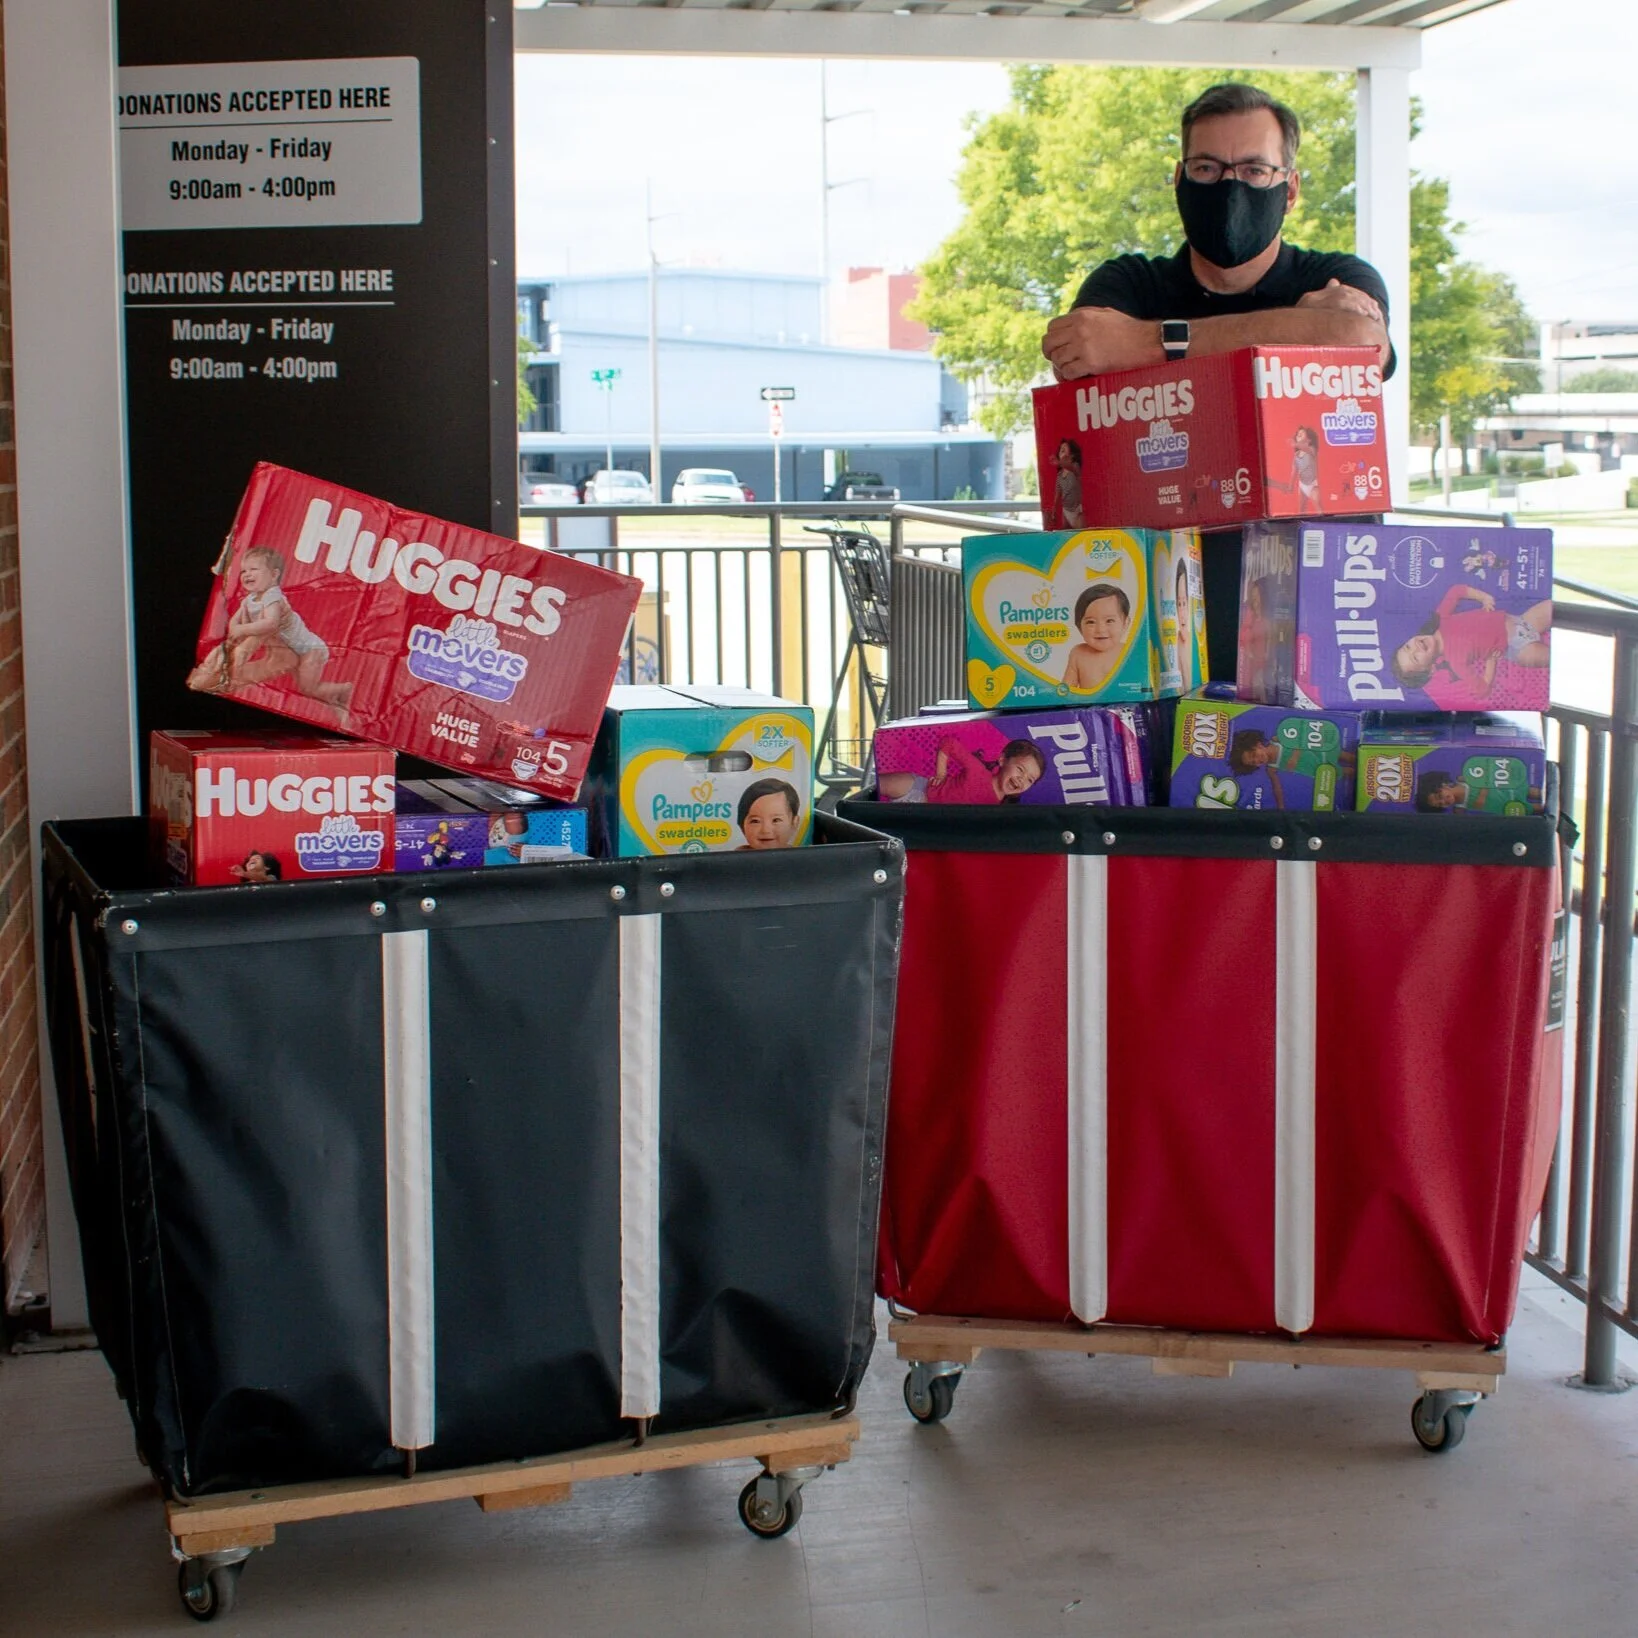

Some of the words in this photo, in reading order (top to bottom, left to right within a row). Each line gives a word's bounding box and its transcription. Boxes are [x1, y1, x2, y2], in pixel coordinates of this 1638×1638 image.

[229, 88, 332, 112] ACCEPTED
[339, 87, 391, 108] HERE
[171, 139, 249, 164] Monday
[270, 137, 332, 162] Friday
[170, 180, 241, 200] 9:00am
[262, 177, 336, 200] 4:00pm
[123, 271, 224, 294] ONATIONS
[230, 271, 334, 293] ACCEPTED
[340, 270, 393, 291] HERE
[172, 319, 251, 344] Monday
[271, 318, 334, 344] Friday
[170, 357, 243, 379] 9:00am
[263, 357, 337, 382] 4:00pm
[1254, 356, 1382, 399] HUGGIES
[1076, 379, 1194, 431] HUGGIES
[1323, 414, 1376, 428] movers
[1138, 434, 1188, 454] movers
[1220, 479, 1235, 492] 88
[1235, 468, 1251, 495] 6
[1354, 475, 1368, 486] 88
[1368, 466, 1382, 489] 6
[1158, 485, 1179, 496] HUGE
[1158, 494, 1181, 505] VALUE
[1092, 540, 1112, 552] 2X
[294, 498, 566, 636] HUGGIES
[1516, 546, 1529, 590] 4T-5T
[1000, 601, 1069, 625] Pampers
[1007, 628, 1067, 639] swaddlers
[412, 628, 524, 677] movers
[985, 677, 994, 692] 5
[1013, 686, 1036, 697] 104
[431, 723, 480, 748] VALUE
[436, 711, 480, 735] HUGE
[761, 725, 783, 739] 2X
[1182, 713, 1193, 751] ABSORBS
[1192, 712, 1218, 757] 20X
[1283, 727, 1298, 739] 6
[1308, 720, 1324, 749] 104
[757, 740, 789, 748] SOFTER
[516, 746, 541, 763] 104
[542, 740, 572, 775] 5
[1365, 757, 1376, 797] ABSORBS
[1377, 755, 1401, 801] 20X
[1469, 766, 1484, 778] 6
[1494, 758, 1511, 787] 104
[195, 767, 396, 817] HUGGIES
[652, 794, 732, 822] Pampers
[298, 834, 381, 850] movers
[659, 825, 728, 839] swaddlers
